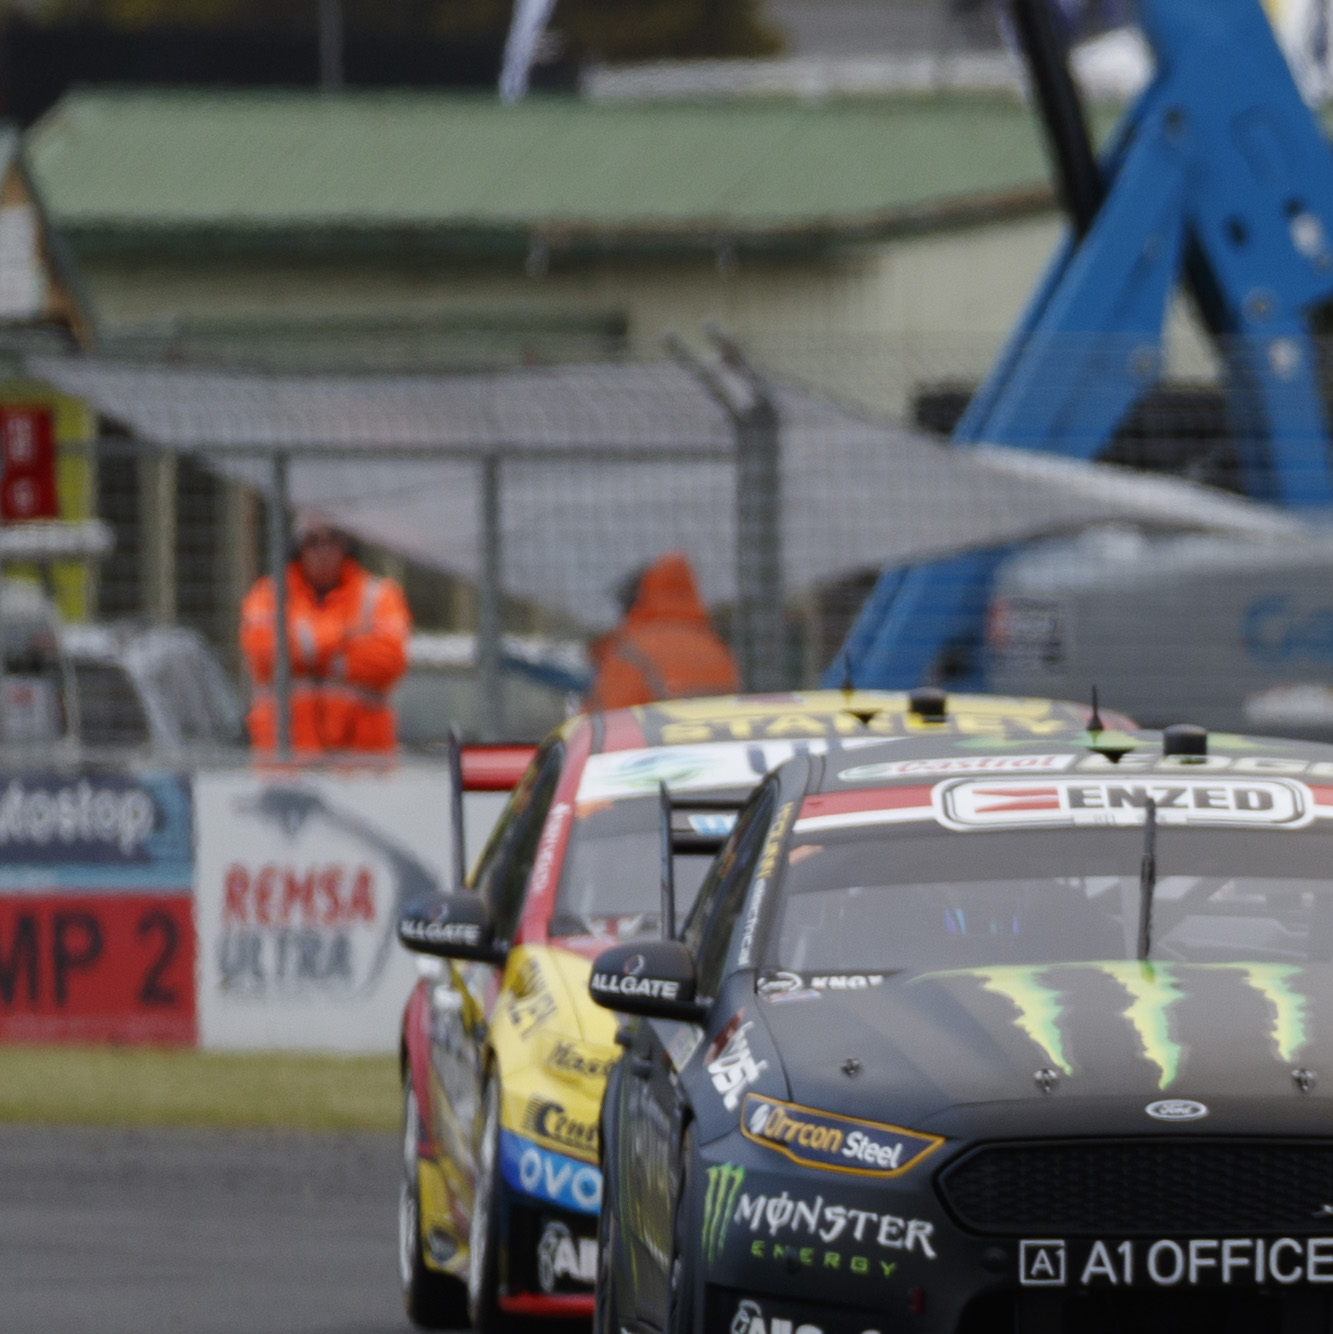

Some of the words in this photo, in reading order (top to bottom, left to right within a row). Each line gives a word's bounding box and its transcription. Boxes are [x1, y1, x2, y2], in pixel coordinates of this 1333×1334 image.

[897, 755, 1056, 774] Castrol
[1066, 785, 1276, 812] ENZED
[137, 905, 179, 1007] 2
[591, 971, 679, 999] ALLGATE
[764, 1105, 844, 1153] Orrcon
[842, 1132, 903, 1170] Steel
[734, 1191, 938, 1259] MONSTER
[751, 1240, 898, 1278] ENERGY
[1081, 1240, 1133, 1285] A1
